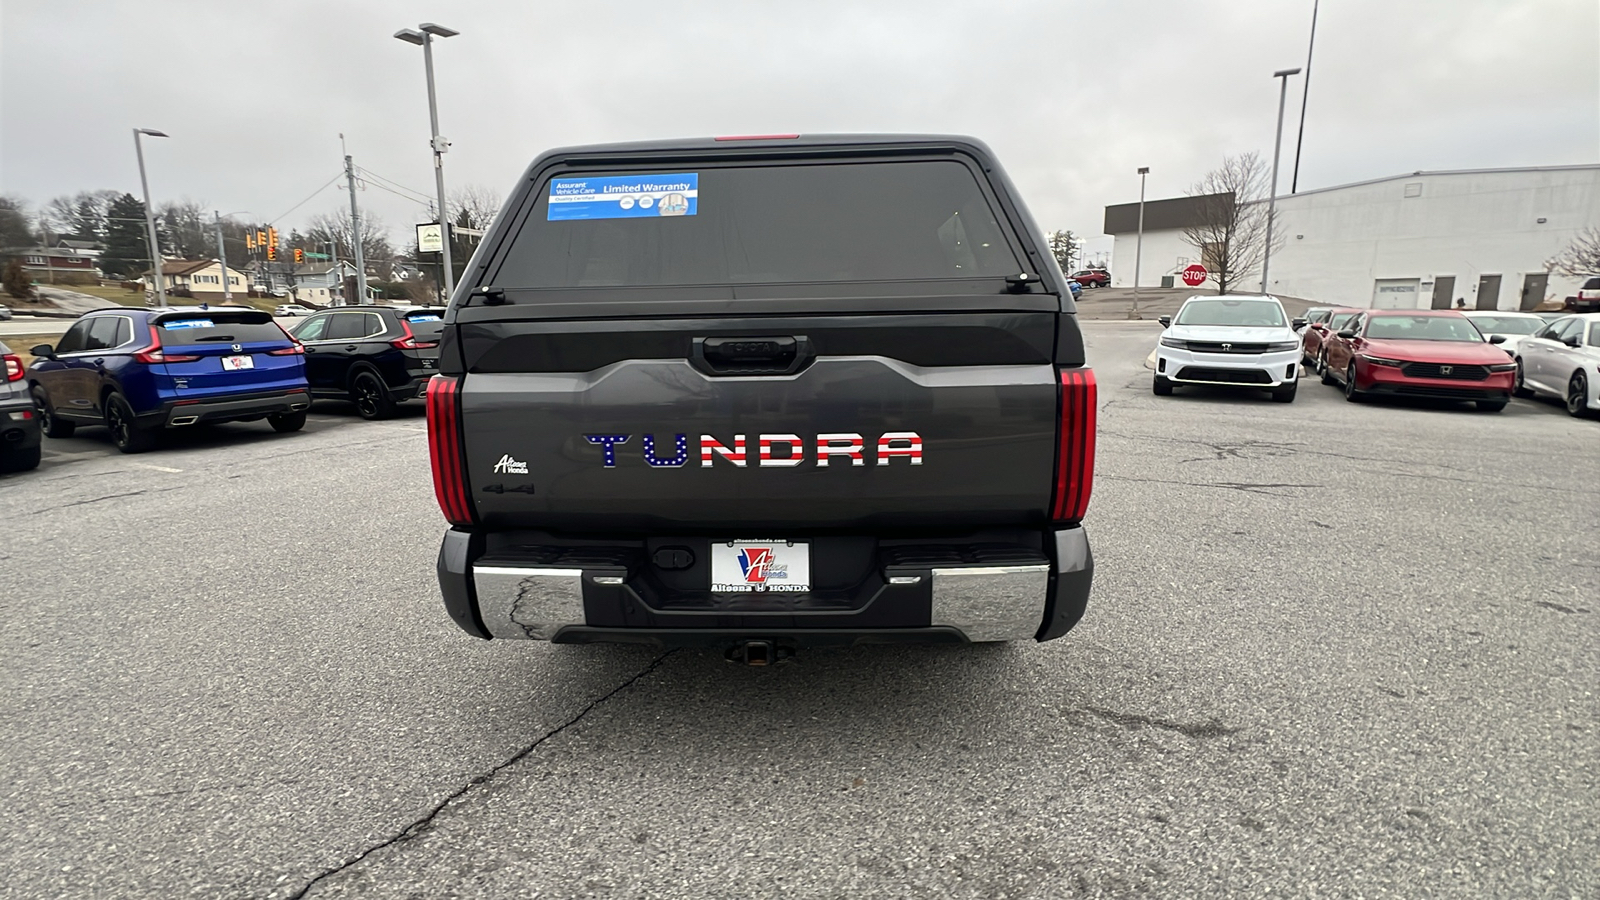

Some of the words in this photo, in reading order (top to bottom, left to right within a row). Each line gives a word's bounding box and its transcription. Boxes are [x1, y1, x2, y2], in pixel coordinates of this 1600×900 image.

[603, 184, 641, 193] Limited
[642, 183, 690, 192] Warranty
[1183, 271, 1206, 280] STOP
[728, 342, 770, 352] TOYOTA
[584, 431, 924, 468] TUNDRA
[711, 584, 752, 592] Altoona
